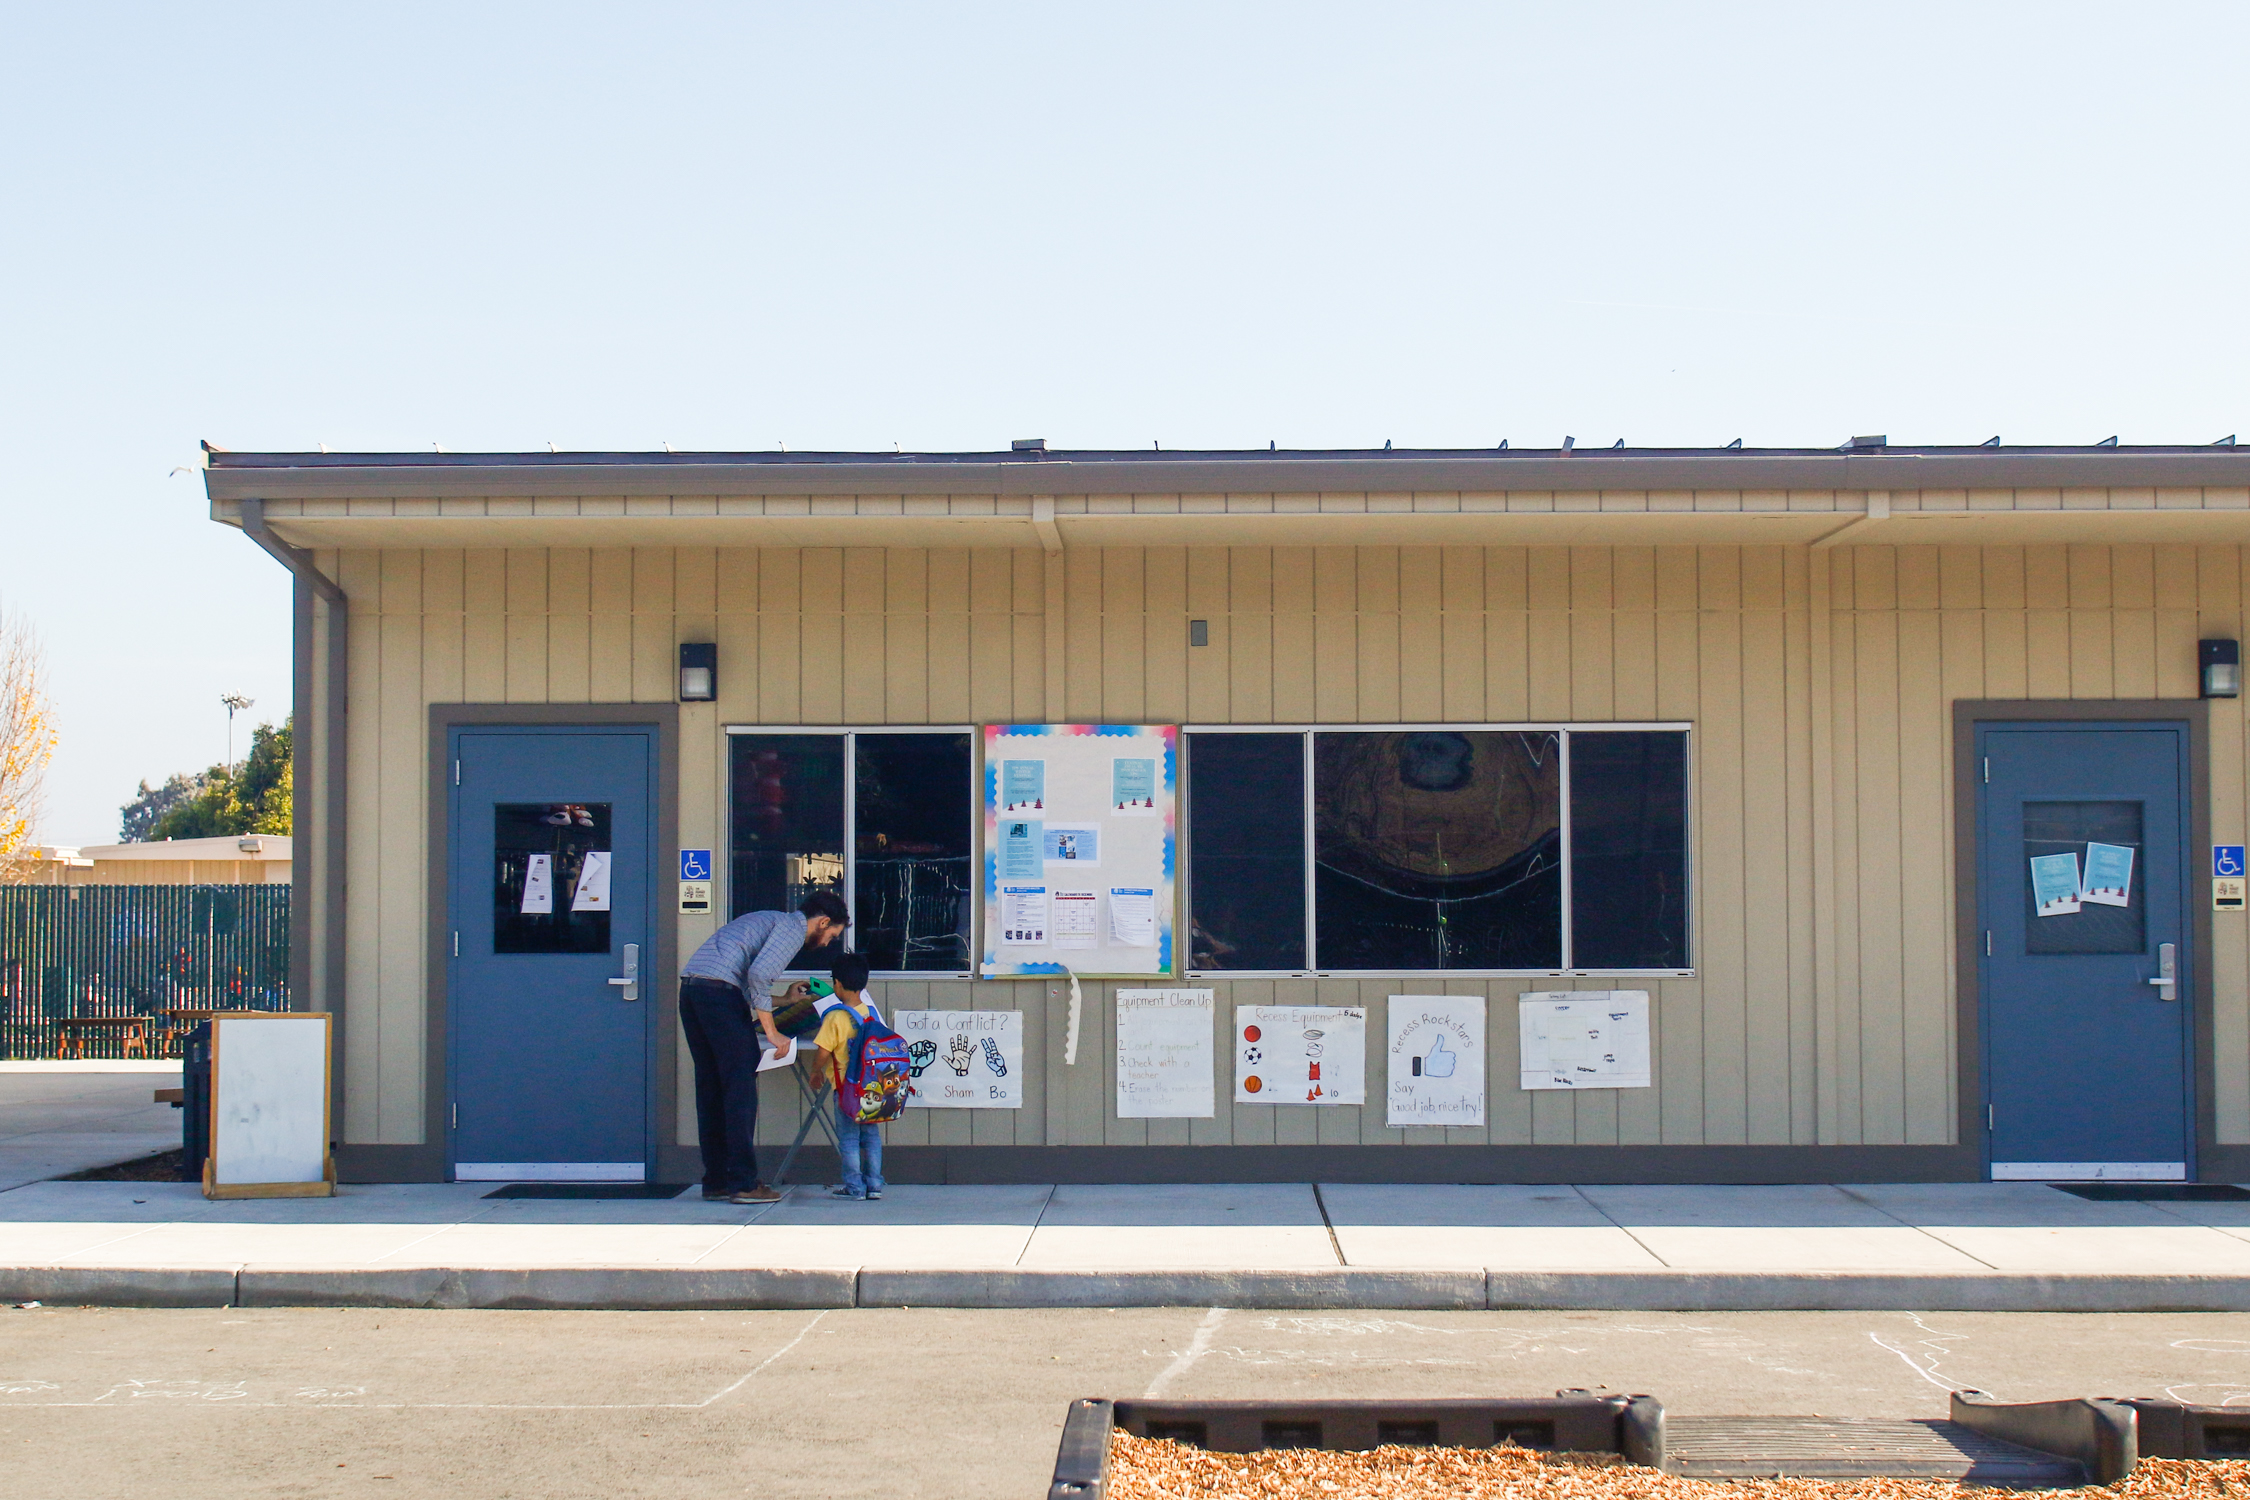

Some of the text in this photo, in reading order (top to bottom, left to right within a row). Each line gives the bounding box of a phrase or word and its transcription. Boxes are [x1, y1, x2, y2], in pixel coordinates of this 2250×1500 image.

[1117, 990, 1212, 1012] Equipment Clean Up
[906, 1012, 929, 1030] Got
[932, 1020, 941, 1031] a
[1255, 1007, 1343, 1029] Recess Equipment
[1392, 1019, 1420, 1053] Recess
[1128, 1040, 1153, 1051] Count
[1159, 1040, 1199, 1054] equipment
[1127, 1057, 1153, 1068] Check
[1158, 1056, 1178, 1068] with
[1128, 1069, 1159, 1079] teacher
[944, 1085, 974, 1098] Sham
[989, 1085, 1007, 1099] Bo
[1129, 1082, 1151, 1093] Erase
[1155, 1082, 1168, 1093] the
[1330, 1088, 1339, 1098] 10
[1394, 1080, 1415, 1096] Say
[1438, 1101, 1459, 1112] nice
